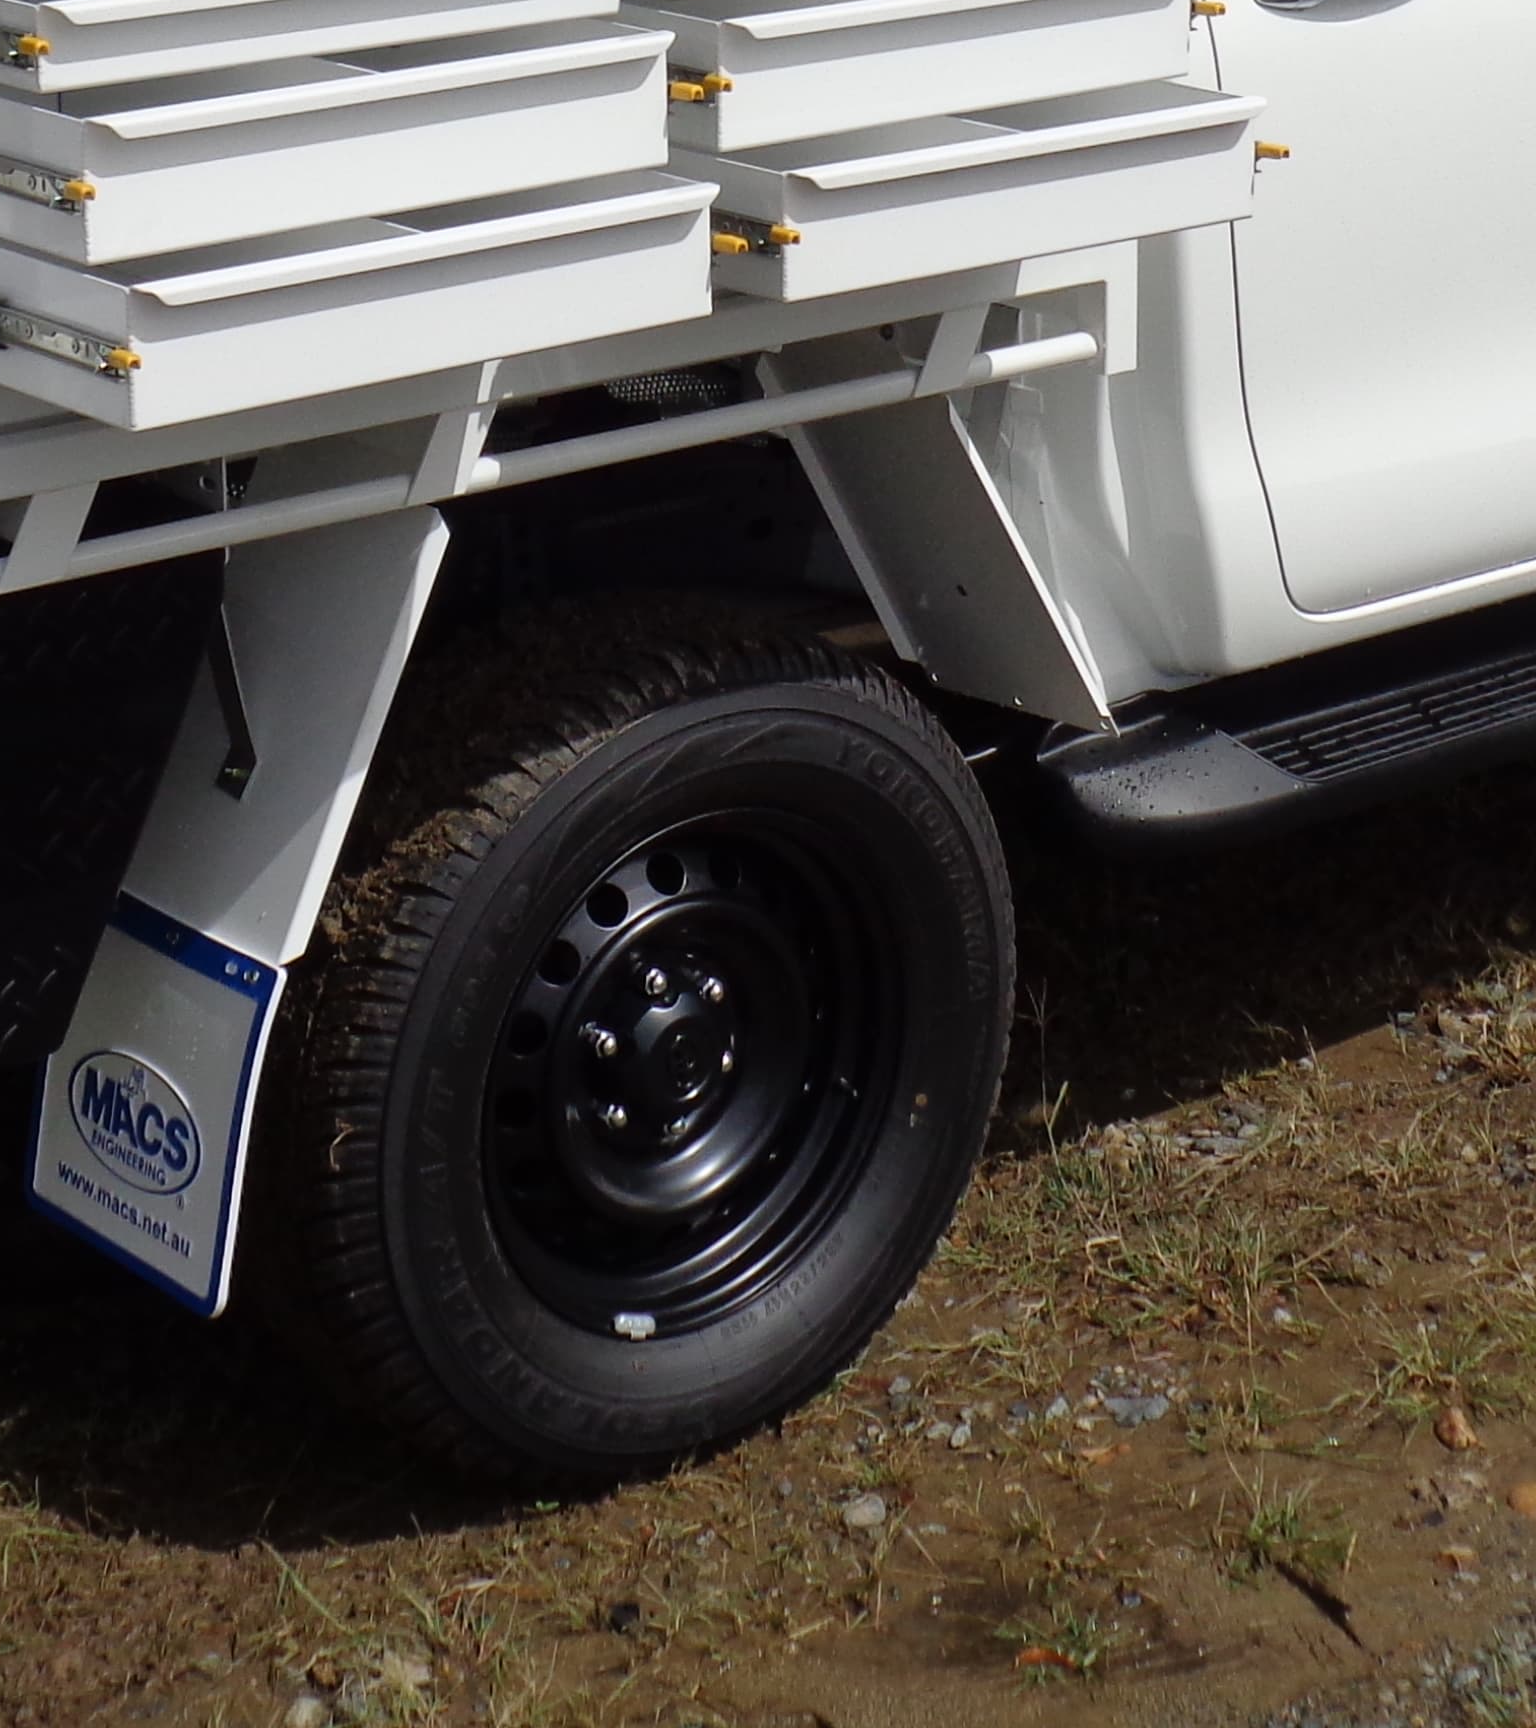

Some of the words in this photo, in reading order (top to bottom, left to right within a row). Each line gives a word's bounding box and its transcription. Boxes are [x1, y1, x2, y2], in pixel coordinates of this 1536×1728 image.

[80, 1065, 191, 1172] MACS
[91, 1129, 167, 1187] ENGINEERING
[57, 1161, 192, 1258] www.macs.net.au
